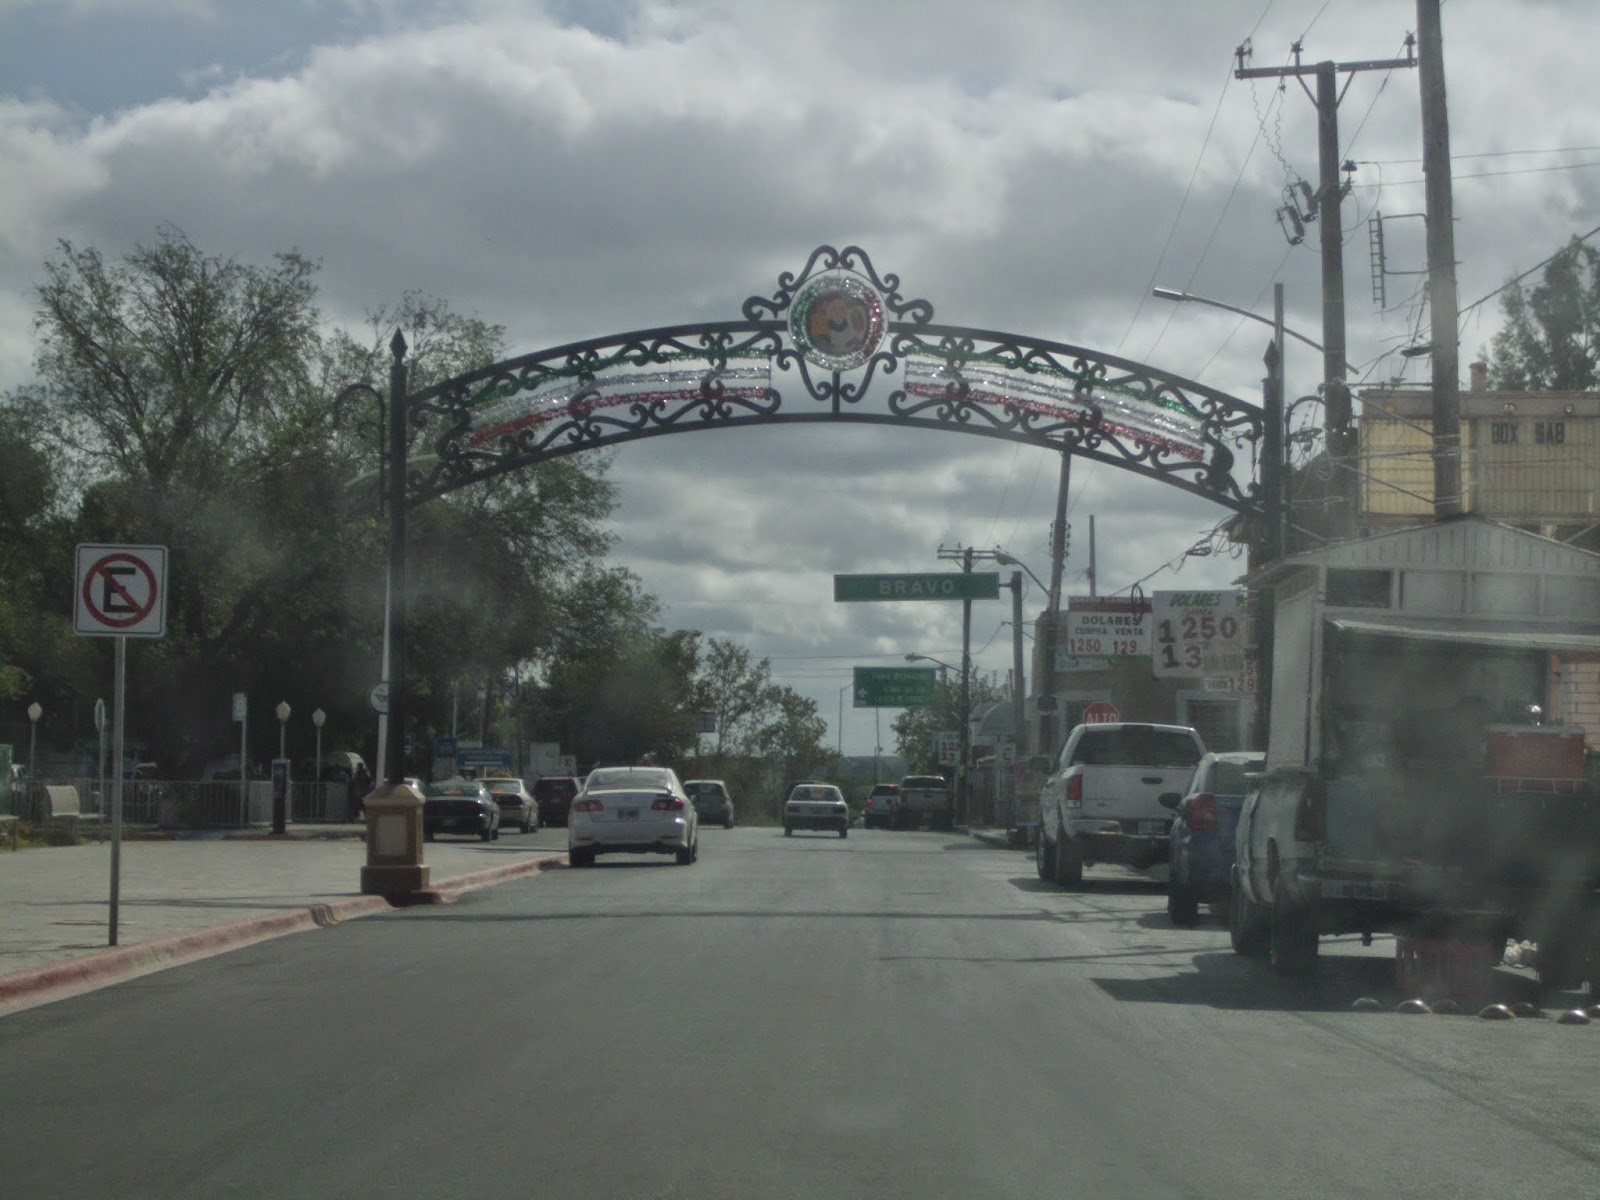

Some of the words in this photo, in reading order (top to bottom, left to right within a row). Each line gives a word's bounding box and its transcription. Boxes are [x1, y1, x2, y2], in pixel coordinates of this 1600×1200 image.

[879, 580, 954, 595] BRAVO
[1169, 593, 1222, 607] DOLARES
[1082, 615, 1141, 626] DOLARES
[1074, 627, 1107, 636] COMPRA
[1114, 627, 1144, 636] VENTA
[1070, 639, 1101, 653] 1250
[1086, 712, 1117, 724] ALTO
